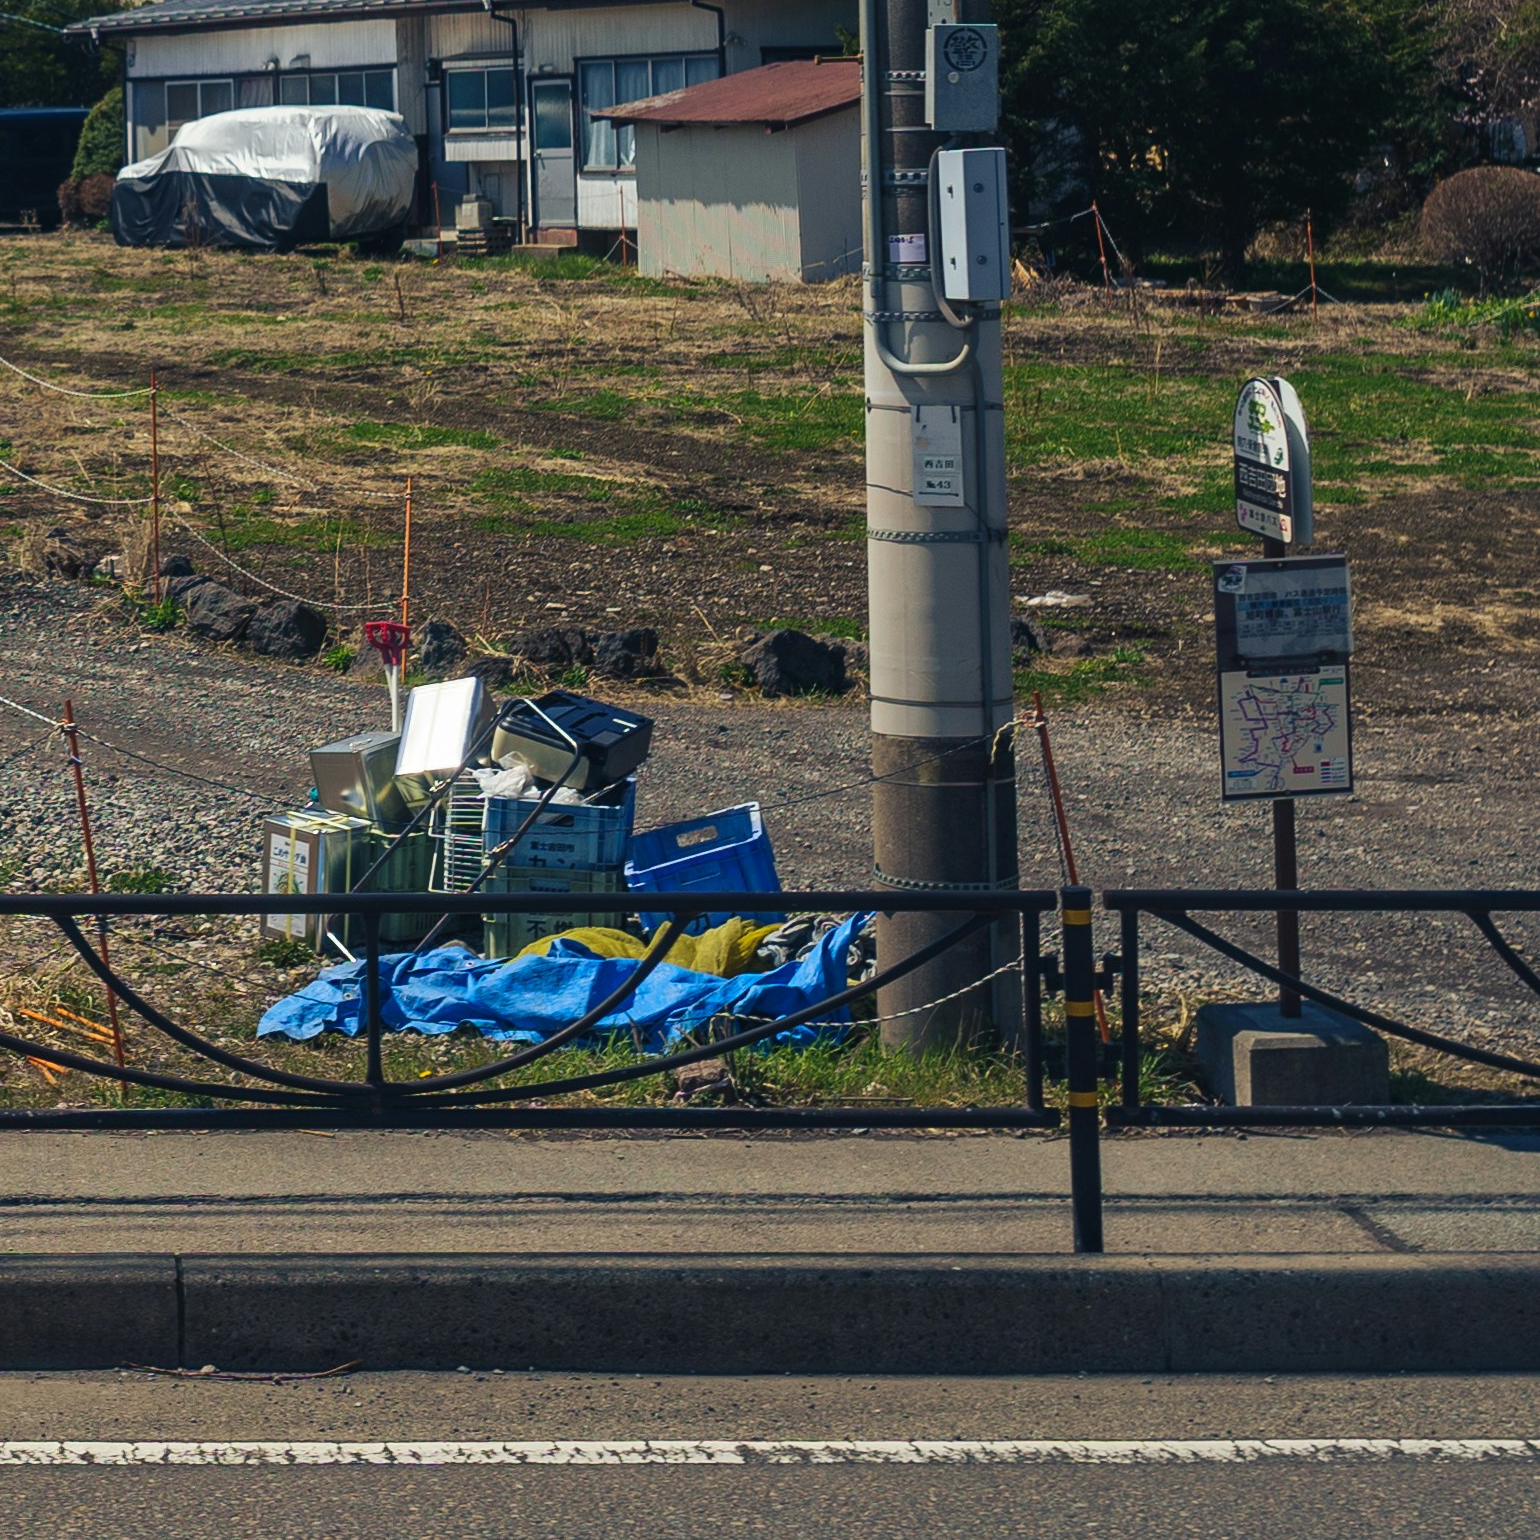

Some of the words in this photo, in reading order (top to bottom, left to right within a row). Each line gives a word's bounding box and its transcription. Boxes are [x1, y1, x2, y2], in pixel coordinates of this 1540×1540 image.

[950, 35, 980, 67] 警
[1238, 461, 1287, 498] 西吉田団地
